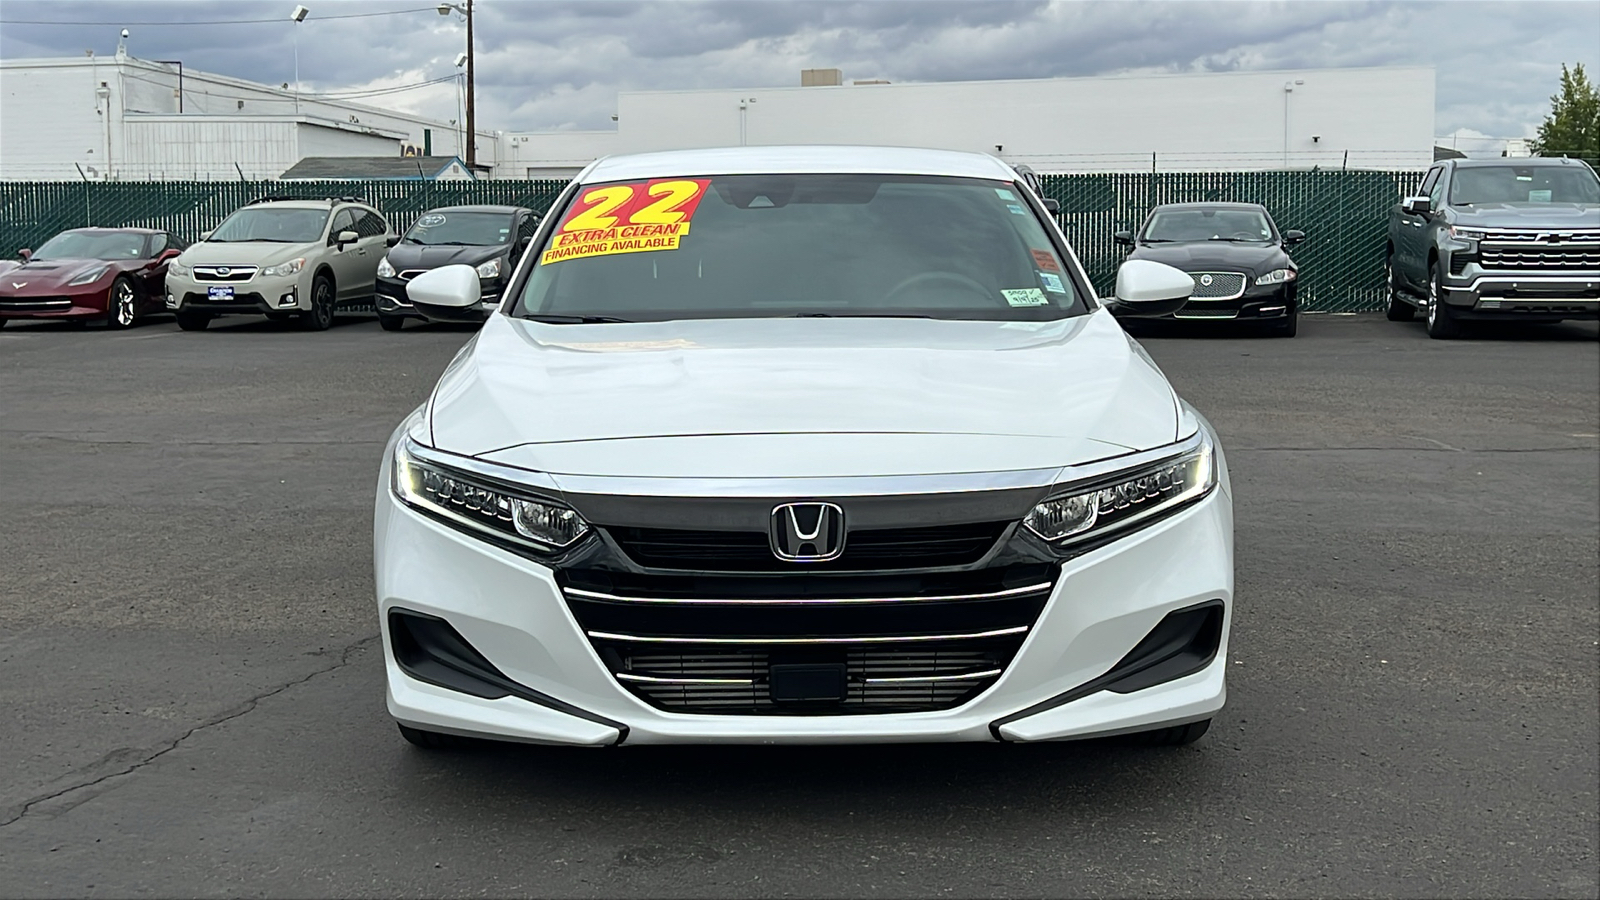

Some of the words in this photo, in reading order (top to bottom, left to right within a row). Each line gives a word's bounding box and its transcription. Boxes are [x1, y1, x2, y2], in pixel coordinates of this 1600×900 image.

[563, 180, 700, 231] 22
[558, 228, 617, 247] EXTRA
[620, 223, 681, 238] CLEAN
[545, 241, 607, 262] FINANCING
[610, 237, 676, 251] AVAILABLE
